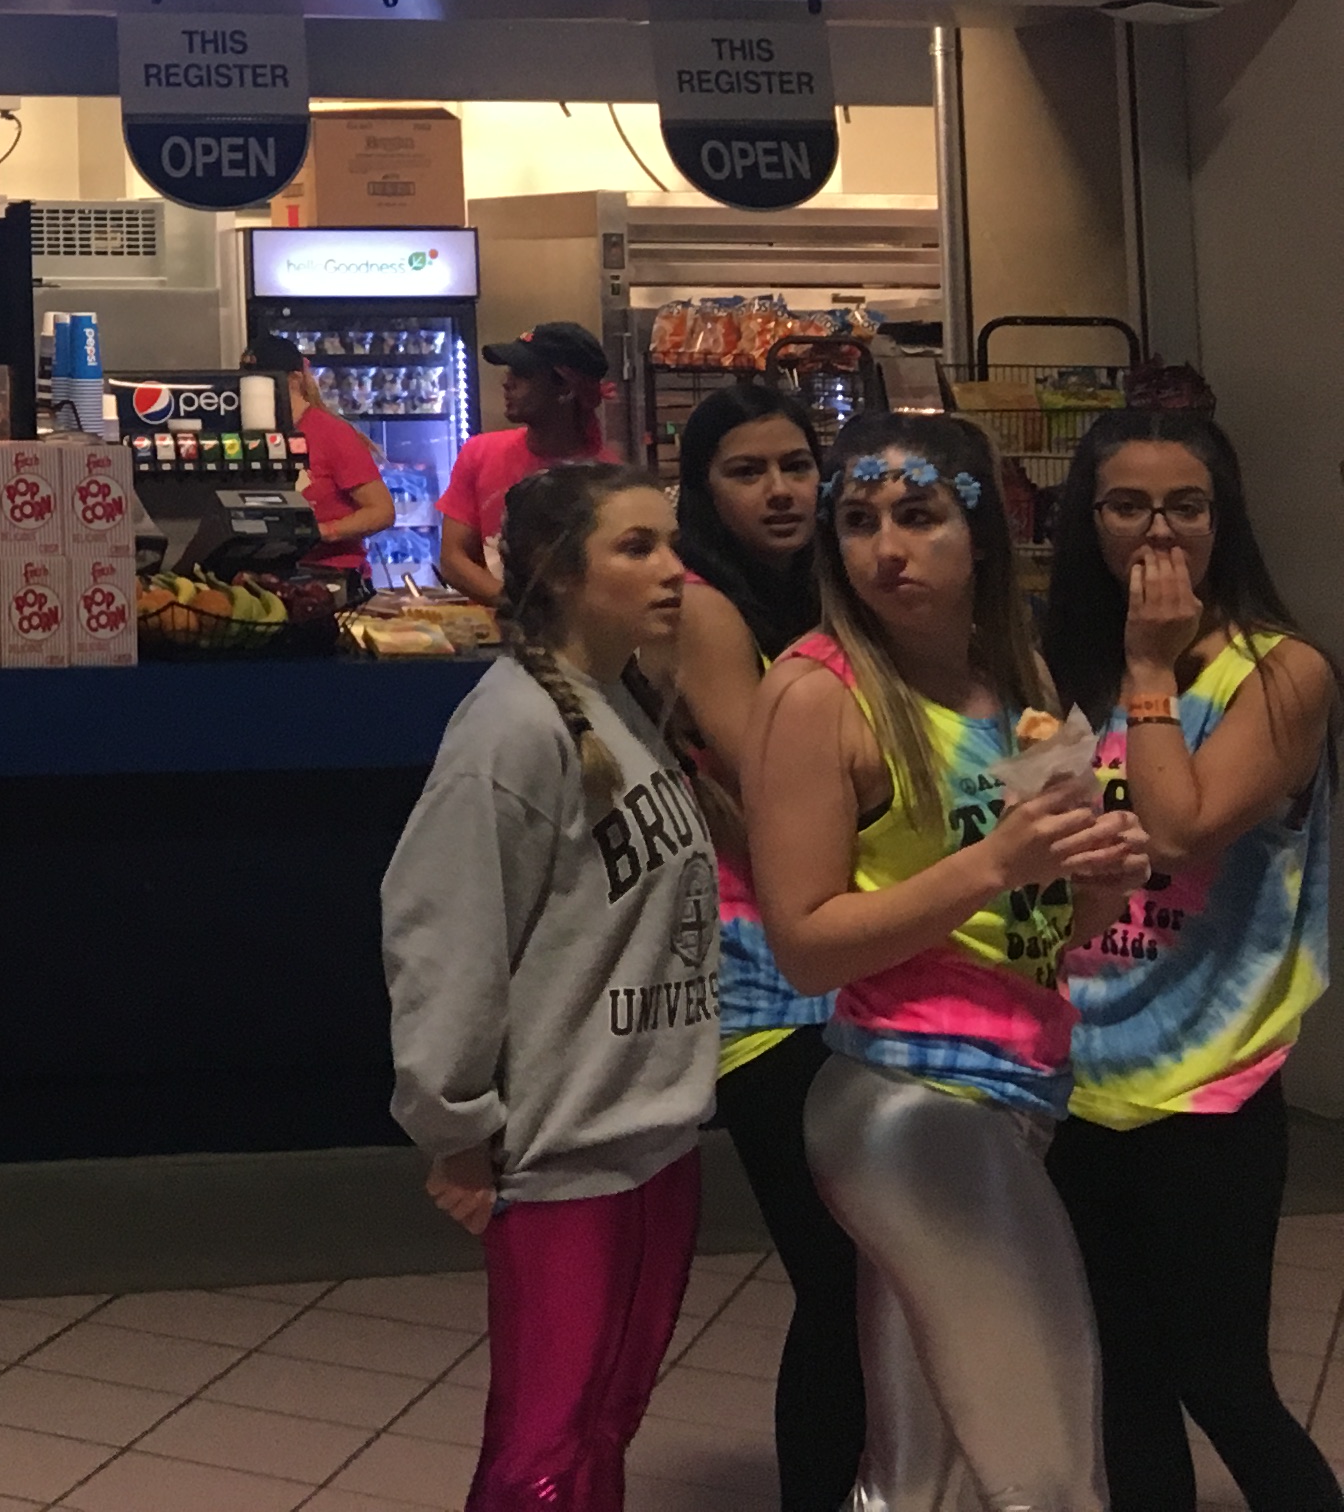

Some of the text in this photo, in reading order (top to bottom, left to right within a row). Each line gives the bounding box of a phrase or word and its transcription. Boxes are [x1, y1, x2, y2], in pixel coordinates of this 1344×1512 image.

[181, 30, 248, 55] THIS
[712, 38, 774, 62] THIS
[144, 63, 289, 88] REGISTER
[677, 70, 814, 95] REGISTER
[162, 136, 277, 178] OPEN
[701, 140, 812, 180] OPEN
[83, 328, 98, 366] pepsi
[179, 391, 239, 416] pep
[6, 478, 40, 504] POP
[77, 479, 111, 505] POP
[10, 494, 52, 522] CORN
[82, 496, 123, 523] CORN
[14, 589, 48, 615] POP
[83, 588, 115, 615] POP
[18, 605, 59, 634] CORN
[86, 604, 126, 632] CORN
[1101, 928, 1159, 961] Kids
